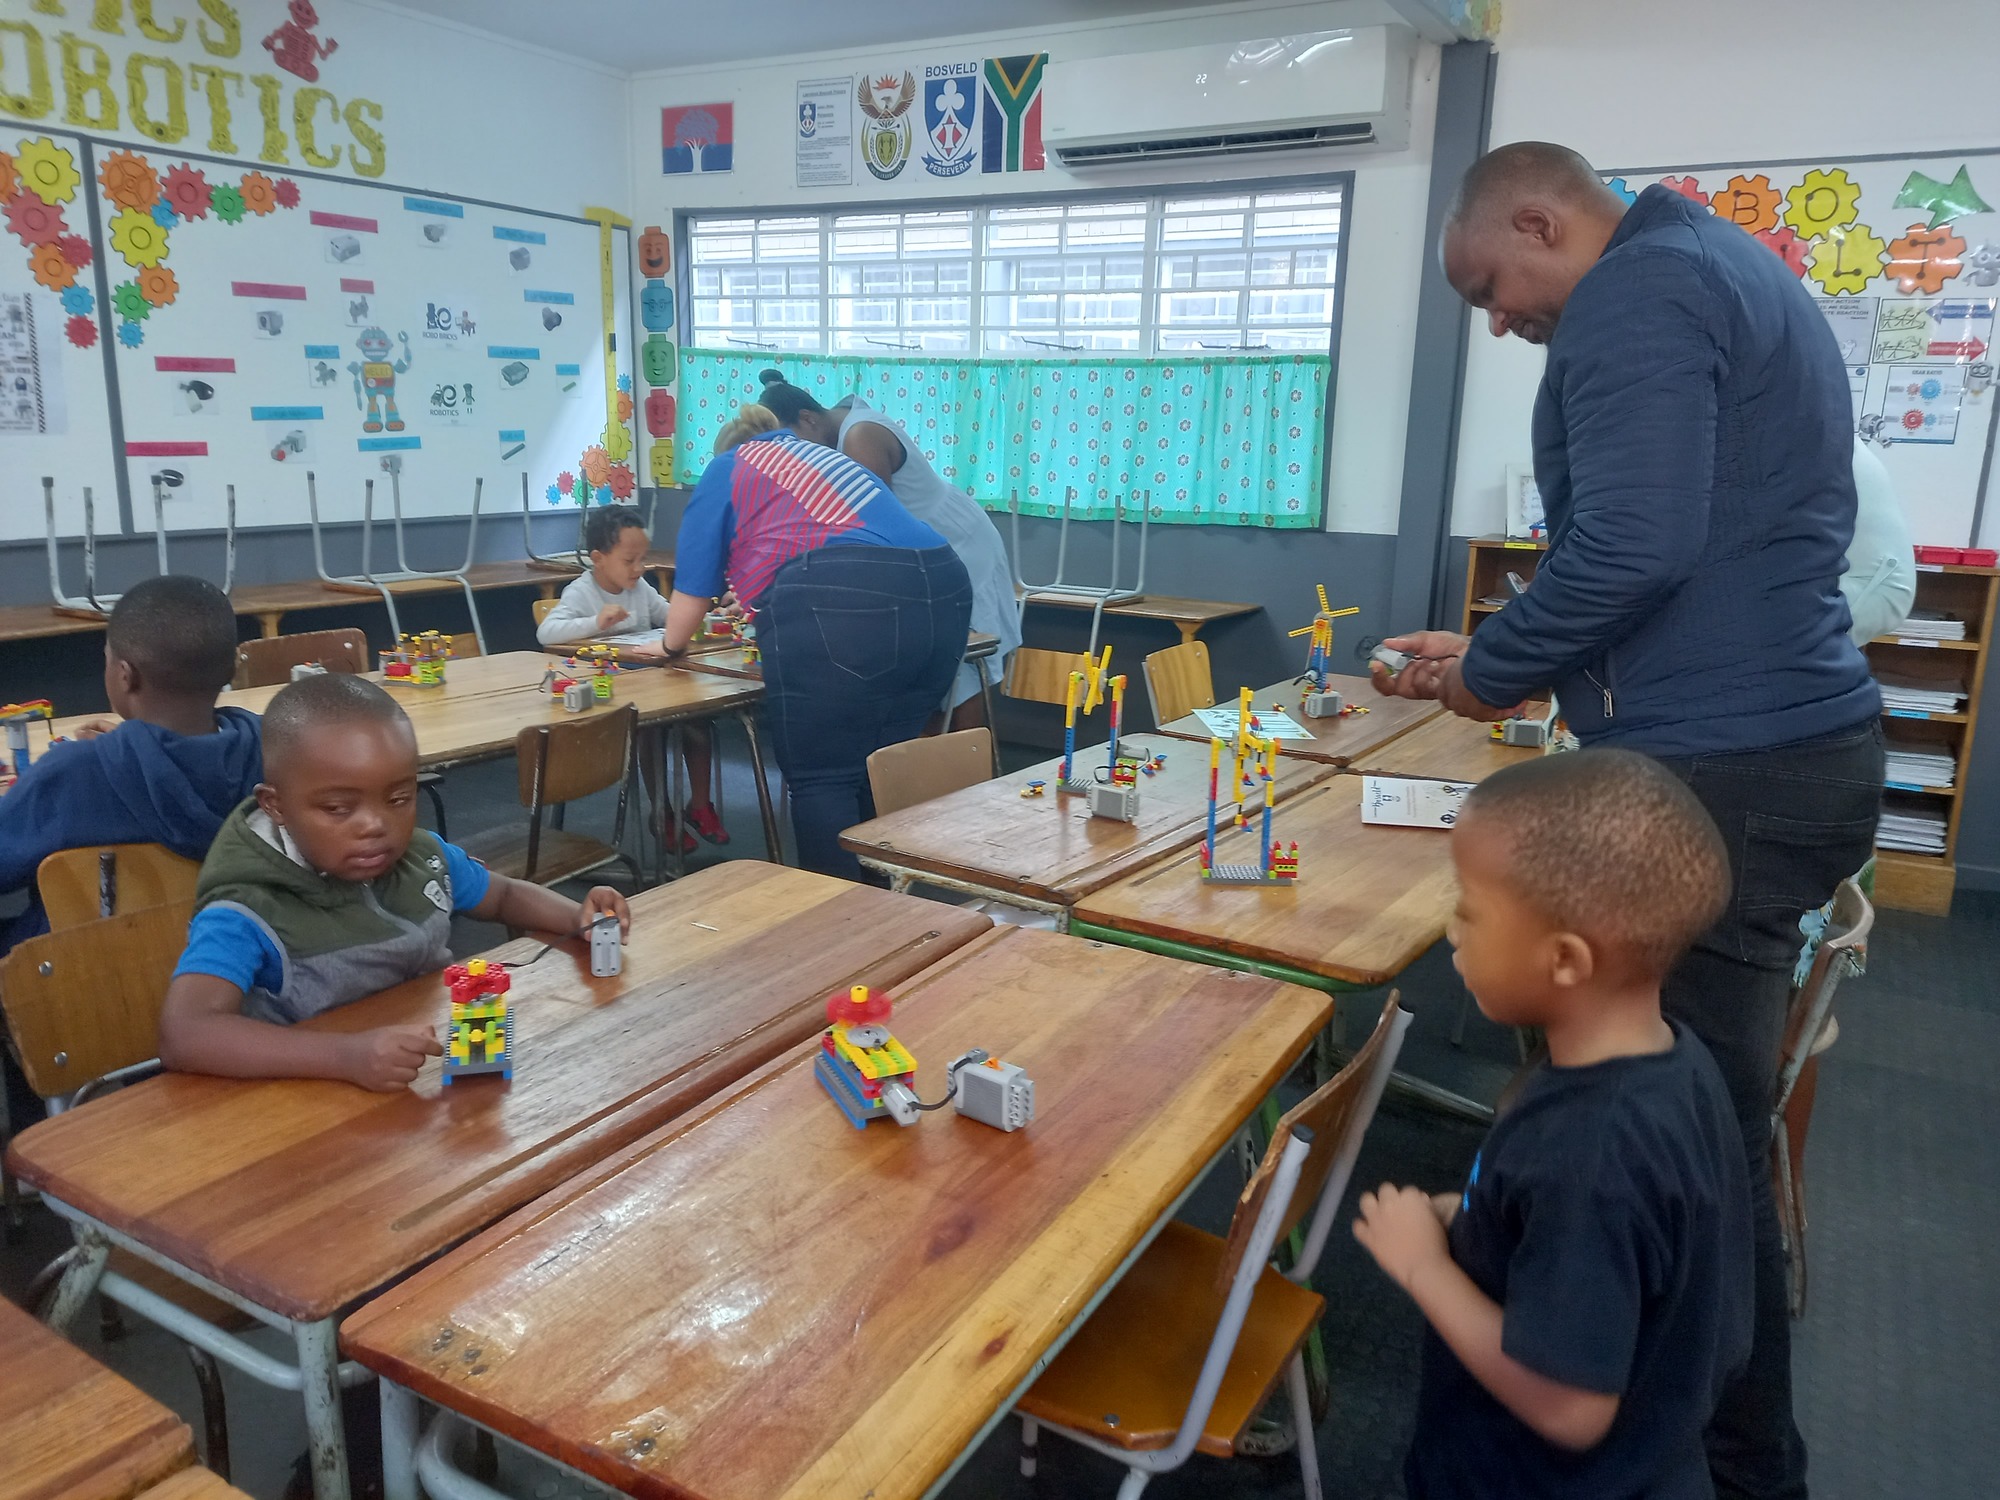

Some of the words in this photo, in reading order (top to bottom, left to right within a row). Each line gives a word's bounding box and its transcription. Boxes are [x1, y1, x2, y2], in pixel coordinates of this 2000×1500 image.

[925, 62, 978, 78] BOSVELD
[1195, 73, 1207, 84] 22
[928, 161, 970, 176] PERSEVERA
[430, 409, 459, 417] ROBOTICS
